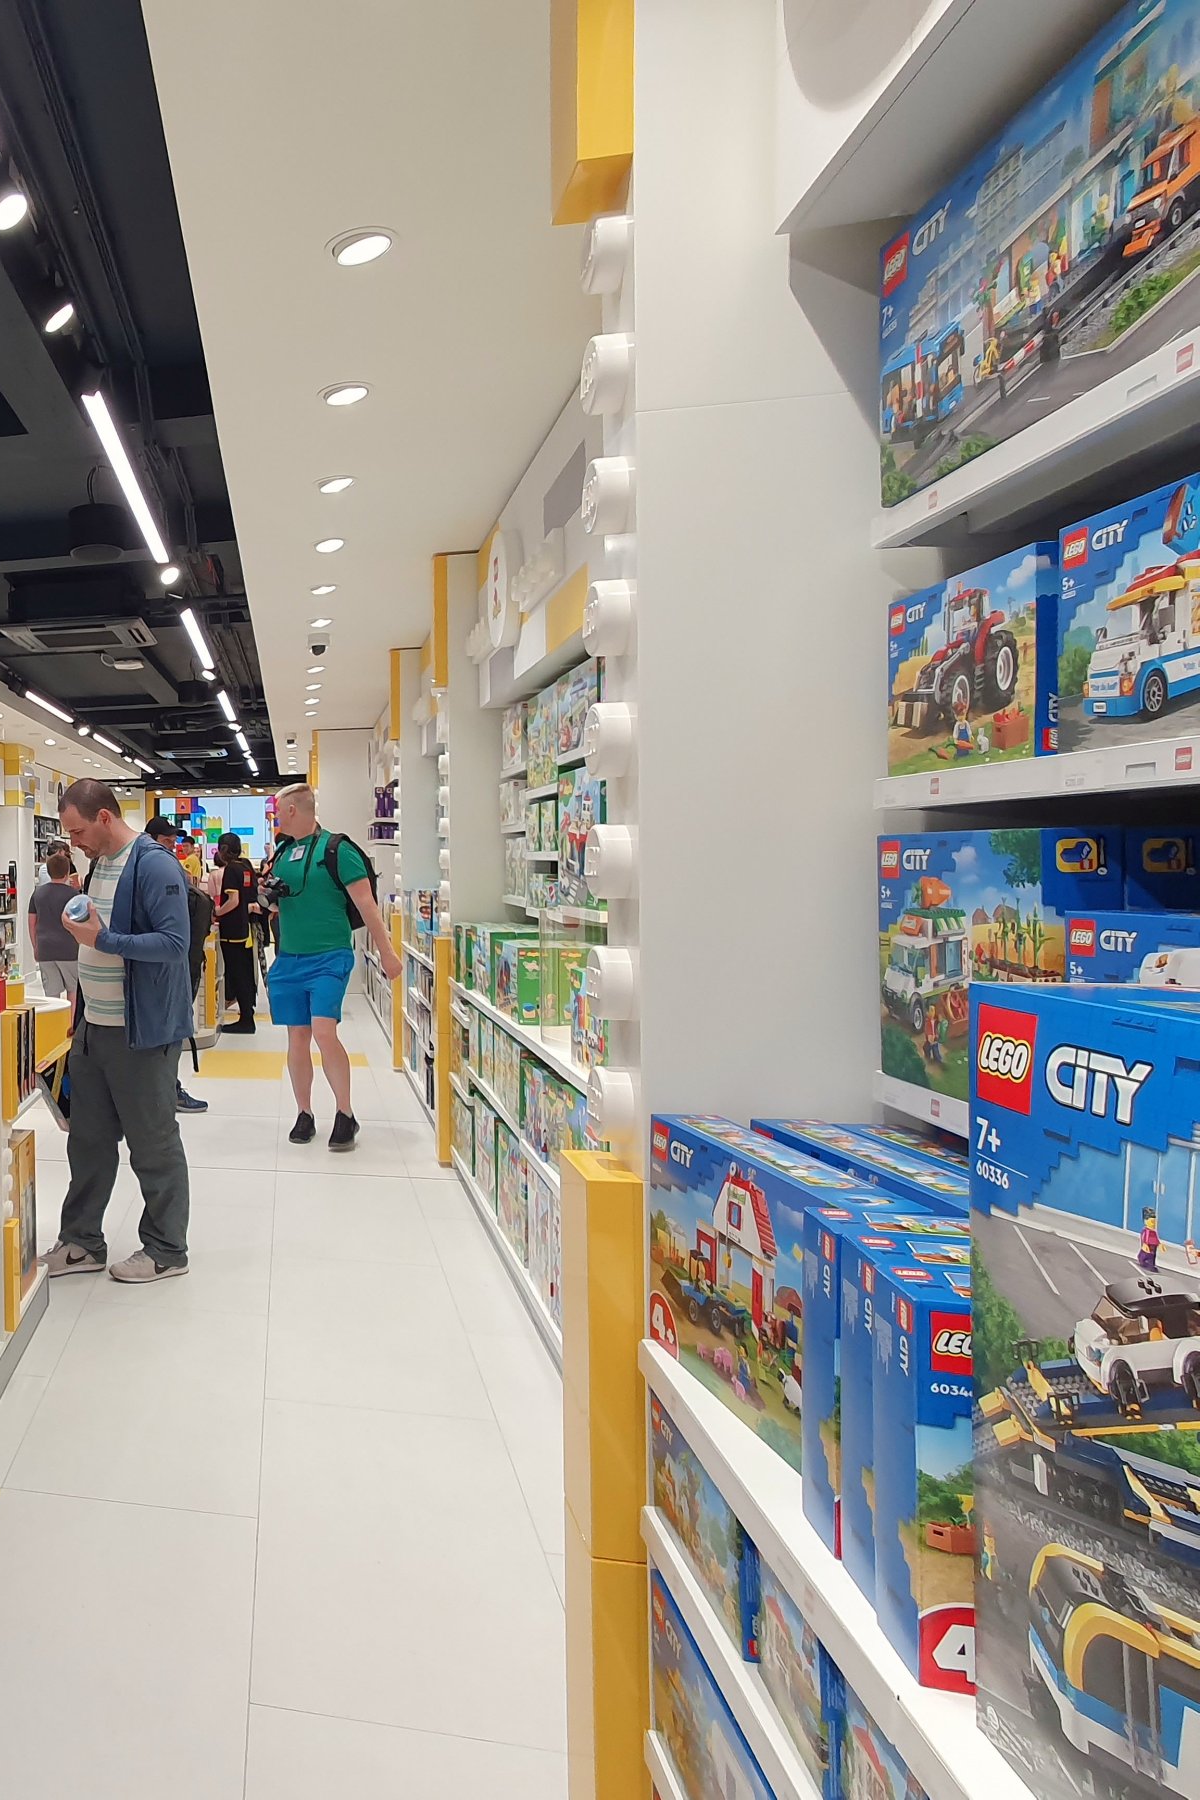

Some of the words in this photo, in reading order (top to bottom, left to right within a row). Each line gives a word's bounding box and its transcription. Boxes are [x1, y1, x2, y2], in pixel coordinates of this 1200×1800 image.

[912, 199, 952, 256] CITY
[1064, 539, 1086, 559] LEGO
[1091, 519, 1129, 551] CITY
[1062, 576, 1075, 591] 5+
[906, 601, 927, 623] CITY
[902, 848, 932, 871] CITY
[881, 886, 892, 899] 5+
[1071, 930, 1093, 945] LEGO
[1099, 929, 1138, 953] CITY
[1069, 961, 1084, 975] 5+
[979, 1033, 1029, 1079] LEGO
[1045, 1045, 1153, 1124] CITY
[975, 1116, 1001, 1153] 7+
[670, 1140, 694, 1169] CITY
[976, 1158, 1010, 1190] 60336
[652, 1303, 674, 1345] 4+
[899, 1335, 909, 1377] CITY
